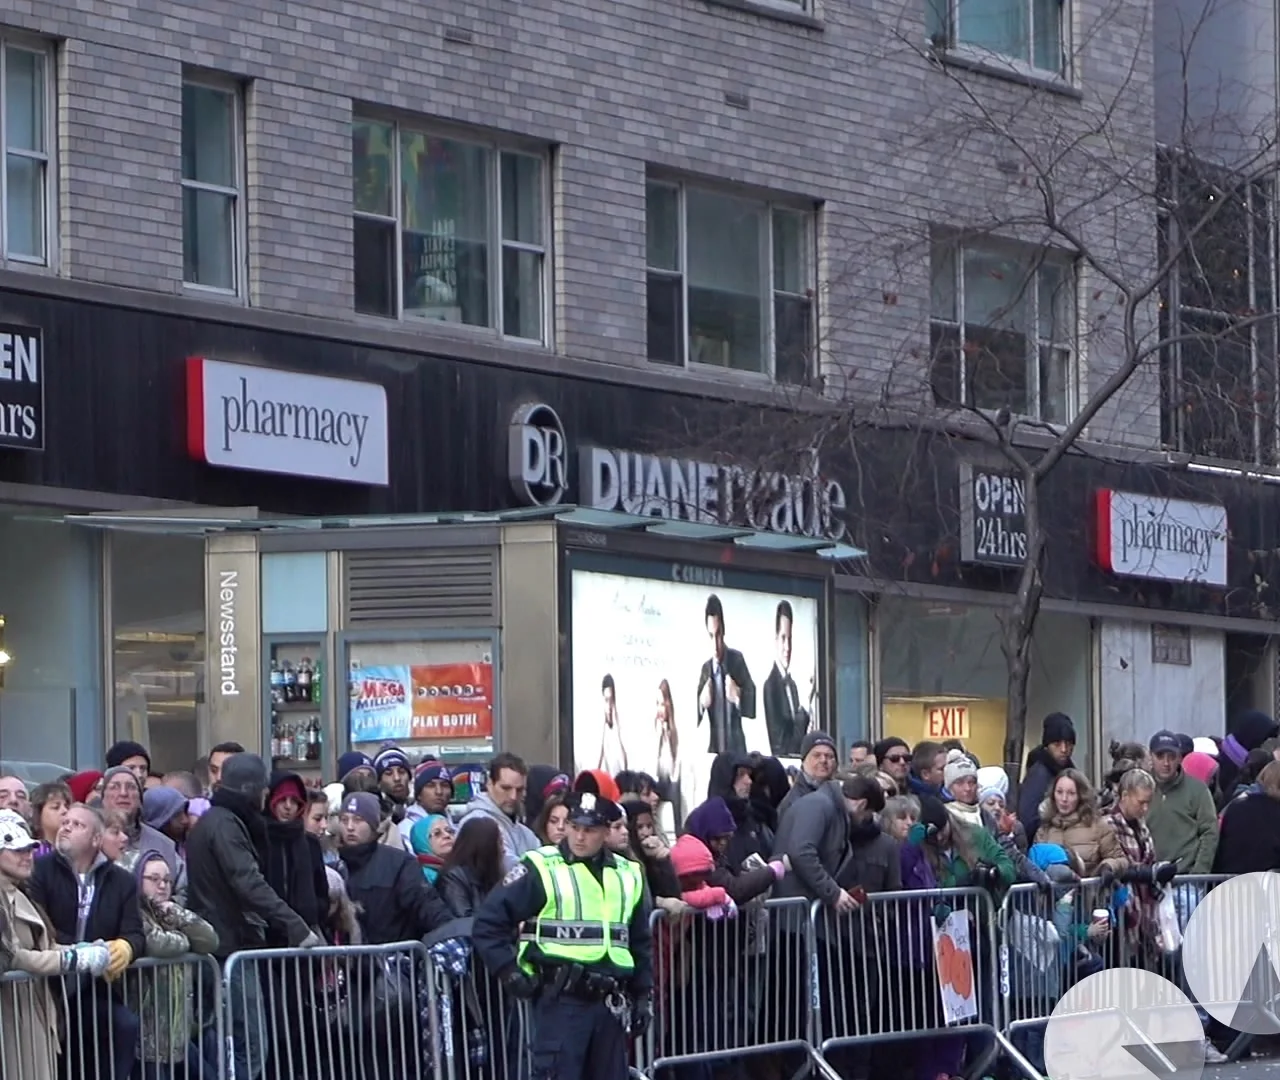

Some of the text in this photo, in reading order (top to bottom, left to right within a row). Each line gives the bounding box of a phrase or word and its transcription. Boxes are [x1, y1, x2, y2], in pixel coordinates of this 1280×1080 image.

[220, 376, 370, 468] pharmacy
[521, 422, 569, 490] DR
[975, 472, 1026, 516] OPEN
[1120, 503, 1214, 573] pharmacy
[219, 571, 240, 696] Newsstand
[361, 680, 406, 699] MEGA
[412, 715, 440, 729] PLAY
[929, 707, 966, 738] EXIT
[556, 926, 585, 939] NY
